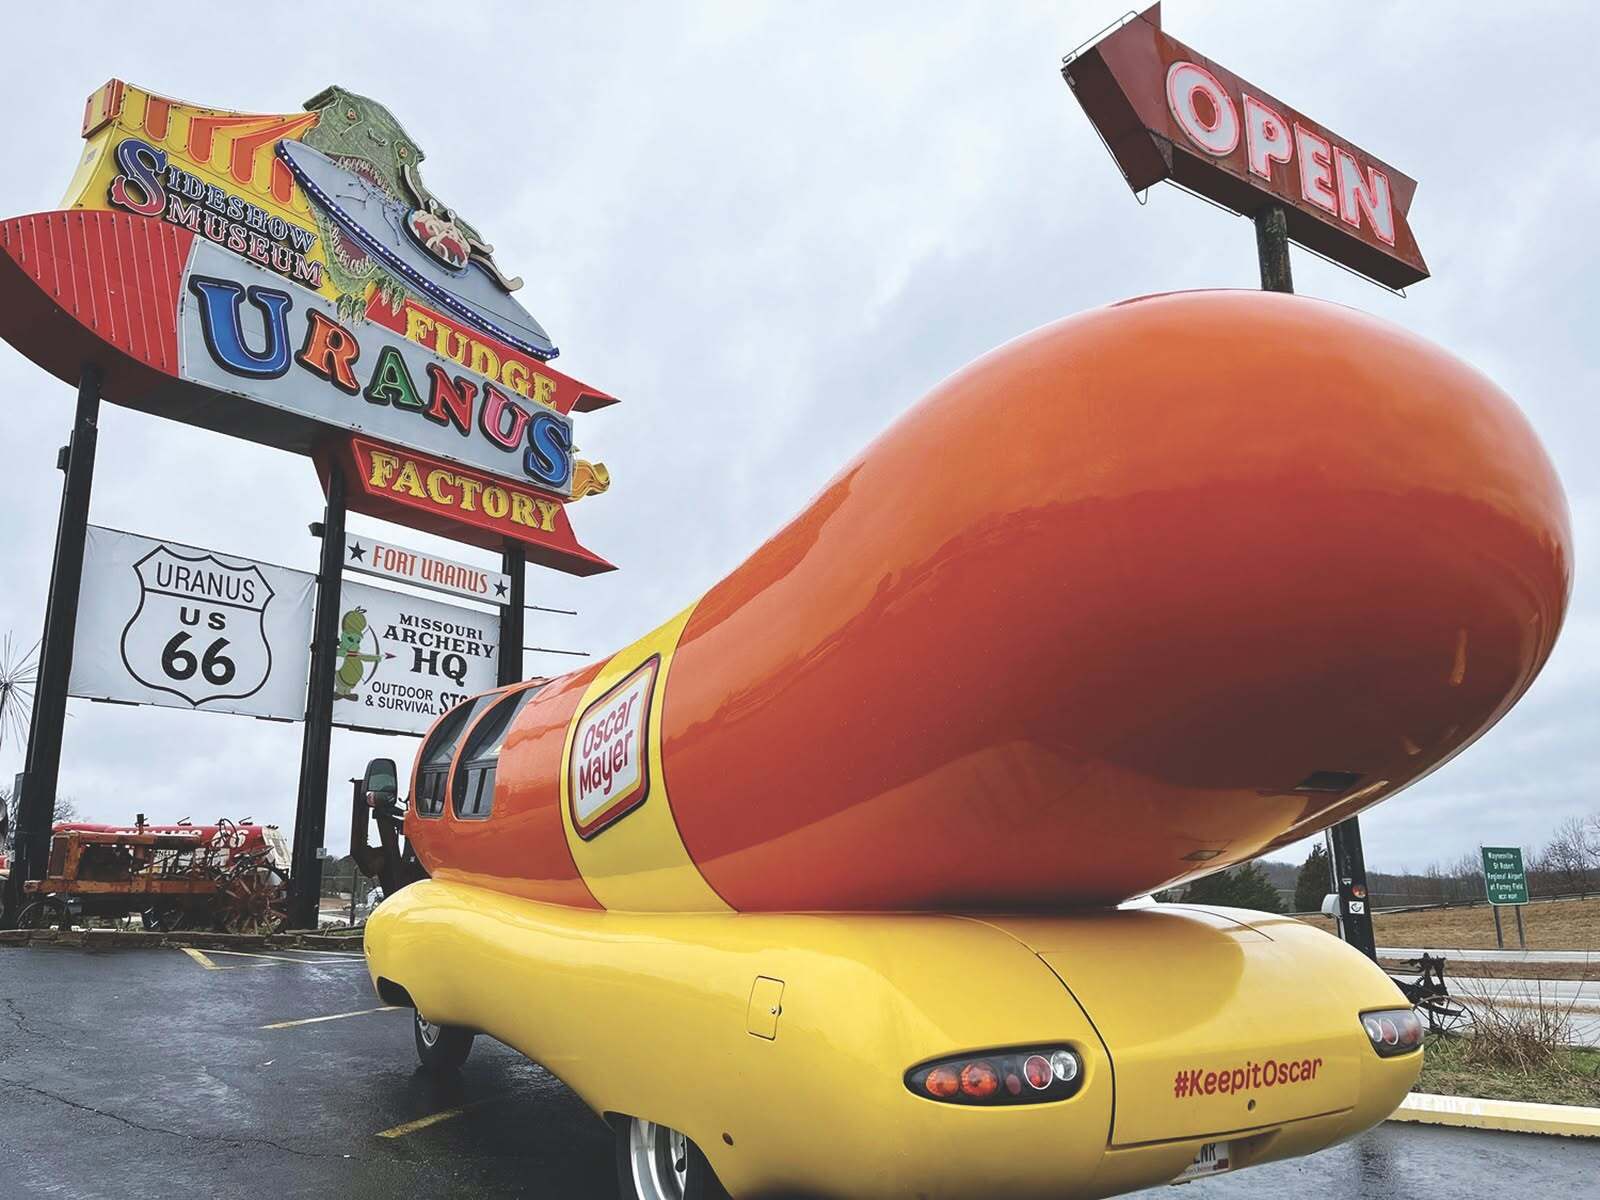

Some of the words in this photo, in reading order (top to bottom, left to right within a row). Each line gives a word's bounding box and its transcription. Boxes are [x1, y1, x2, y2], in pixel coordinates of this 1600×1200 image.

[1166, 61, 1396, 247] OPEN
[110, 138, 318, 253] SIDESHOW
[167, 194, 323, 288] MUSEUM
[189, 275, 573, 487] URANUS
[405, 305, 558, 411] FUDGE
[369, 450, 561, 532] FACTORY
[156, 562, 255, 604] URANUS
[373, 545, 417, 577] FORT
[420, 558, 488, 594] URANUS
[383, 625, 495, 659] ARCHERY
[399, 612, 483, 641] MISSOURI
[161, 631, 236, 686] 66
[410, 646, 468, 688] HQ
[365, 694, 374, 707] &
[377, 696, 437, 716] SURVIVAL
[371, 681, 433, 701] OUTDOOR
[582, 691, 639, 760] Oscar
[579, 729, 634, 800] Mayer
[1174, 1057, 1323, 1098] #KeepitOscar
